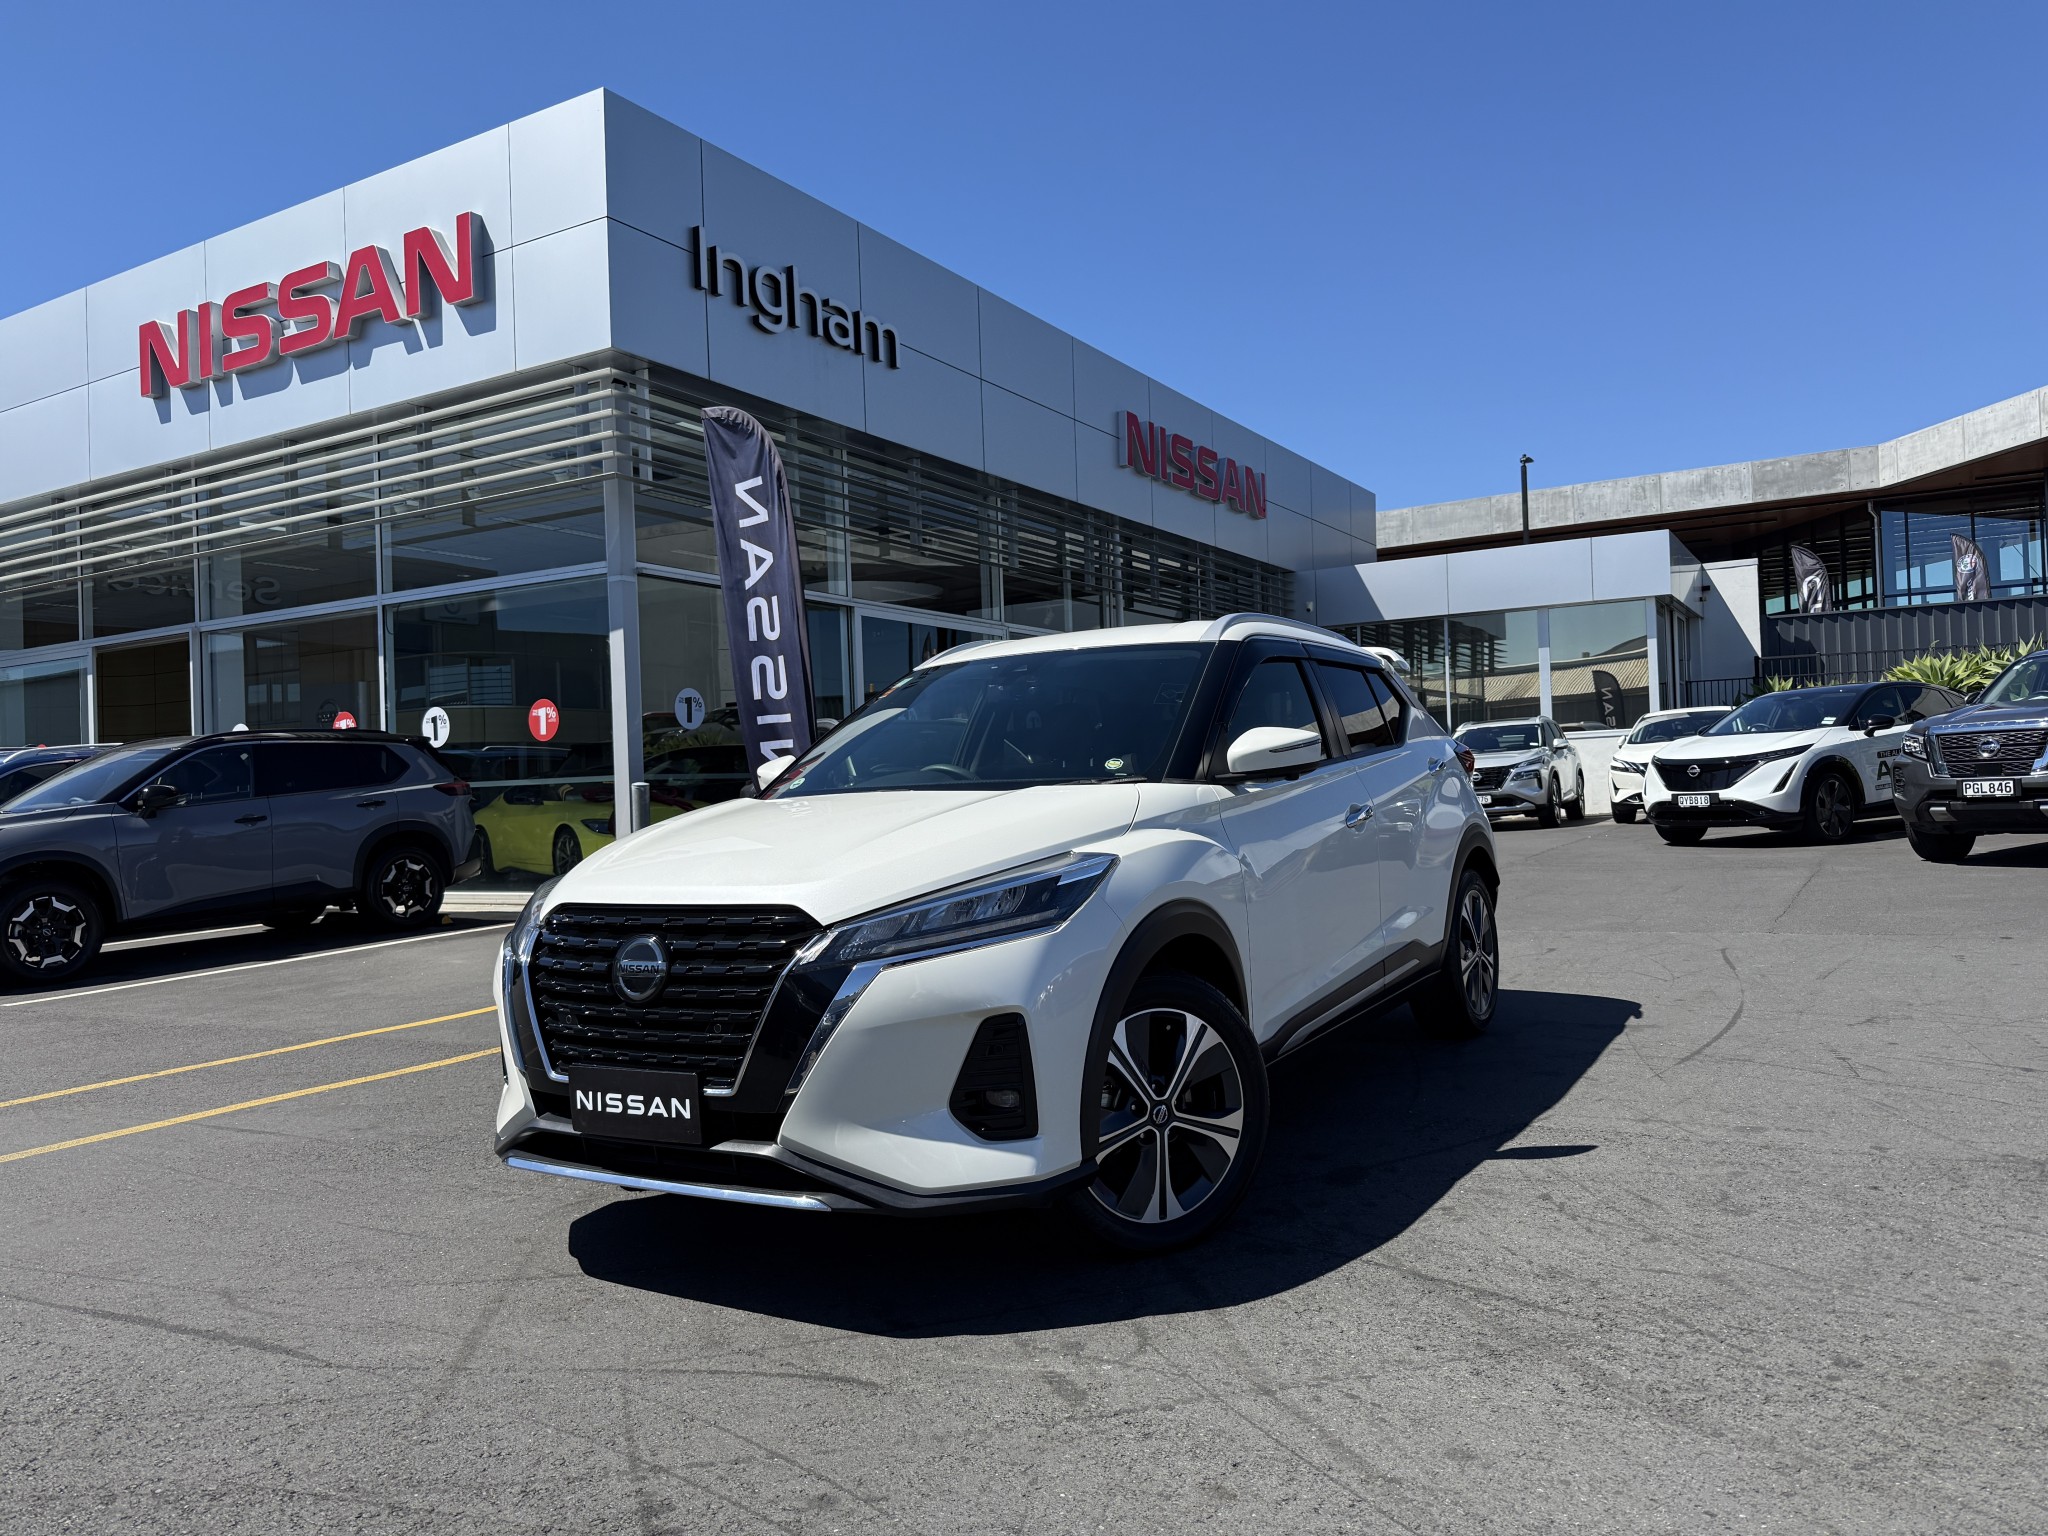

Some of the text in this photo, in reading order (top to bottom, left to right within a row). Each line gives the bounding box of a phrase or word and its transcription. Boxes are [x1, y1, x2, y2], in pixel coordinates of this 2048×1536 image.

[139, 211, 477, 397] NISSAN
[693, 225, 900, 369] Ingham
[1119, 410, 1267, 519] NISSAN
[538, 707, 556, 735] 1%
[685, 697, 702, 723] 1%
[431, 715, 447, 741] 1%
[1964, 782, 2012, 794] PGL846
[619, 964, 660, 974] NISSAN
[576, 1090, 691, 1119] NISSAN
